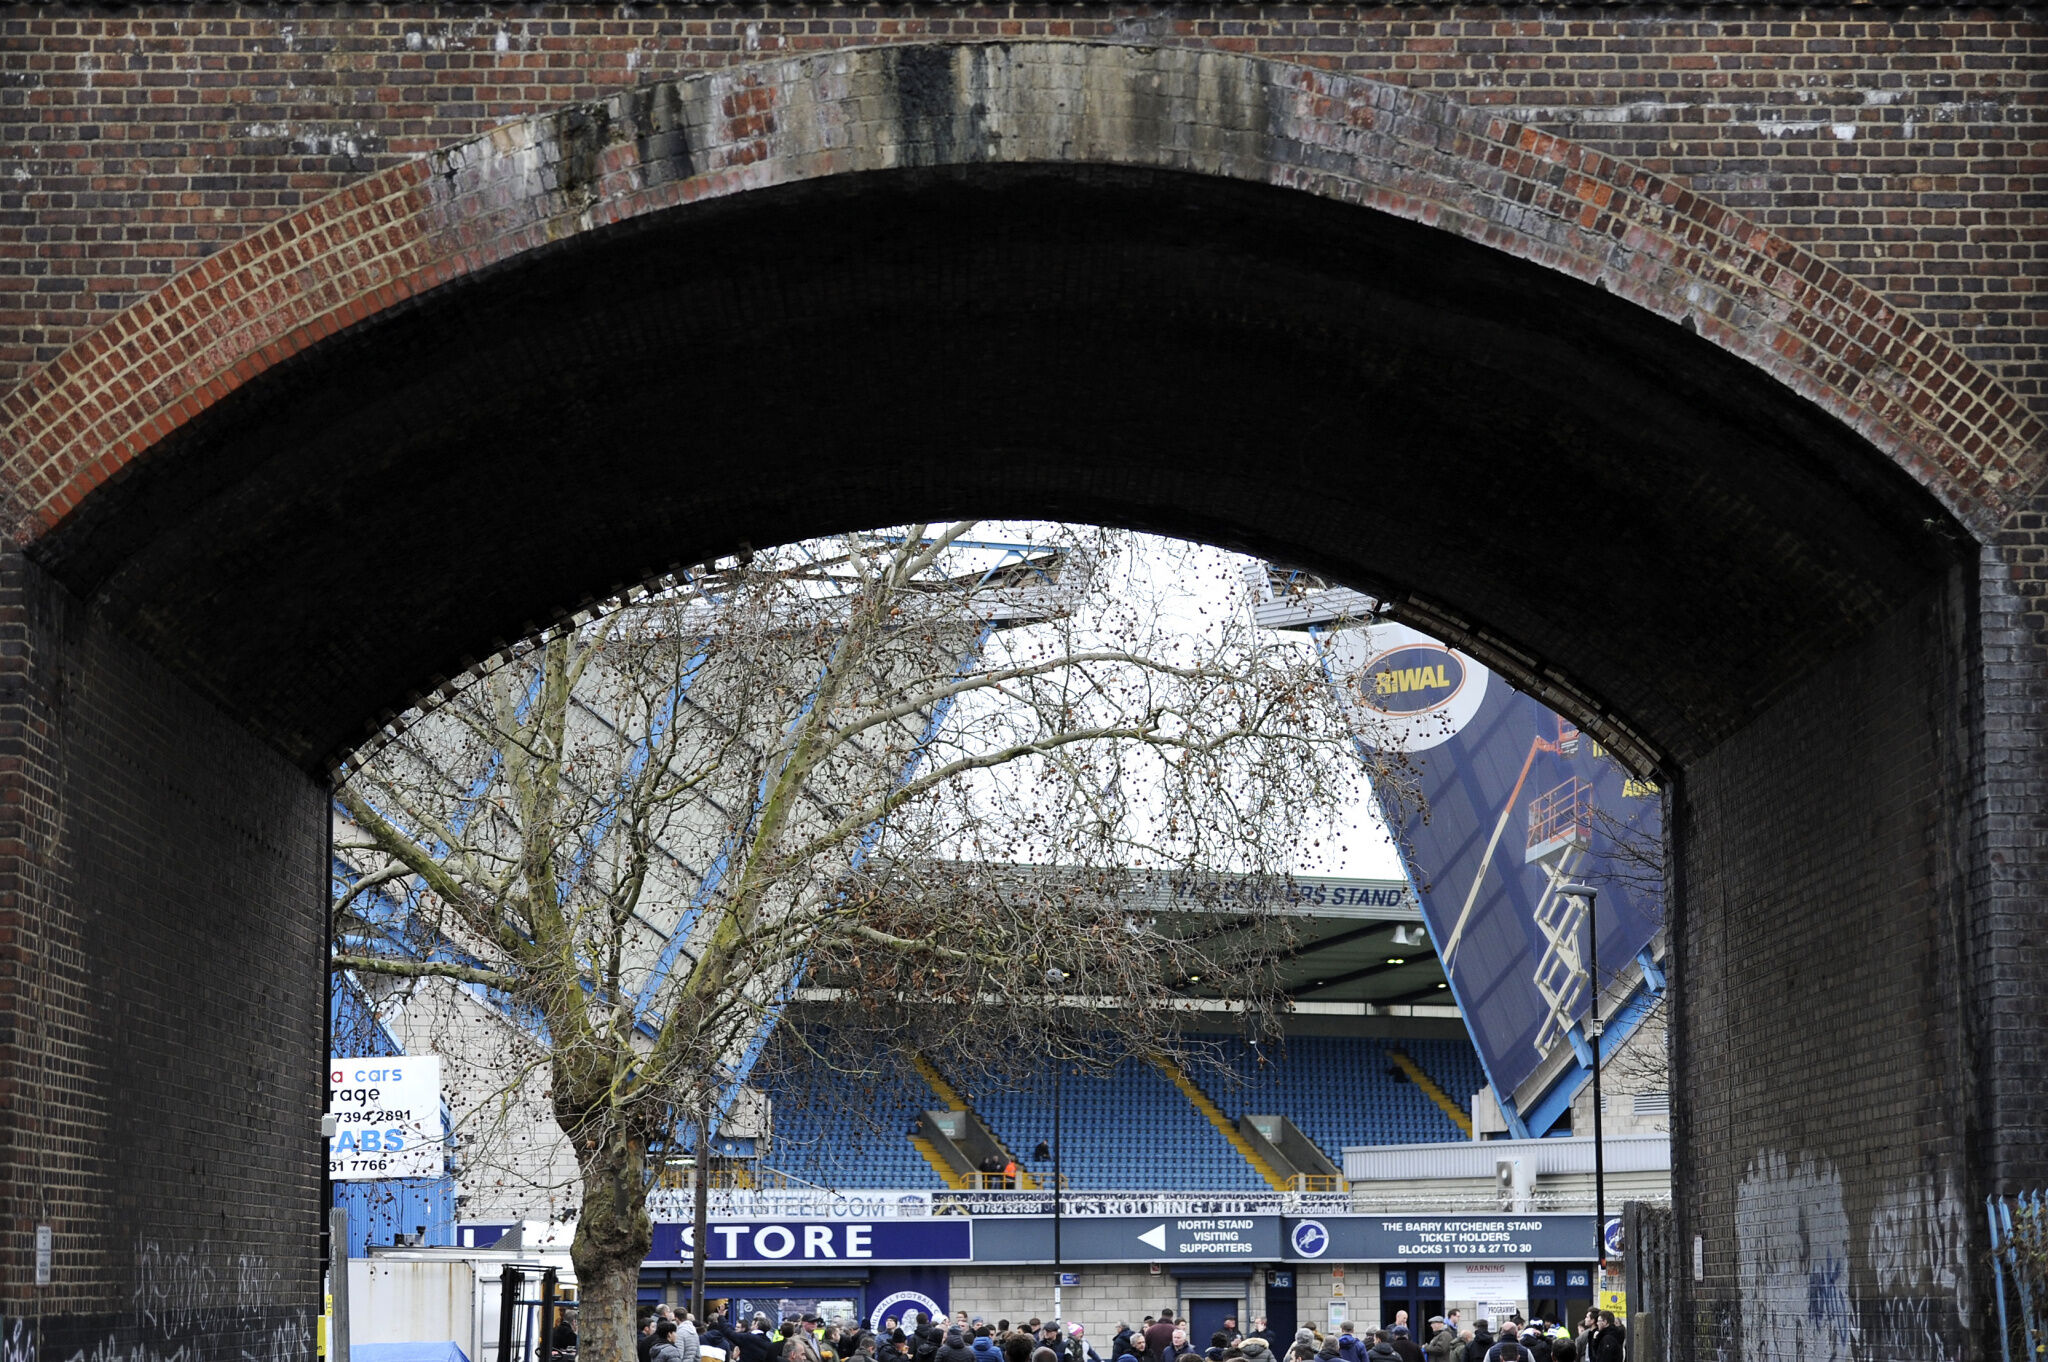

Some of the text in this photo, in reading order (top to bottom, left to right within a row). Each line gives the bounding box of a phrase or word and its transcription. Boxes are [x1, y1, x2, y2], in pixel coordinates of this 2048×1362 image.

[1376, 665, 1450, 695] RIWAL
[1332, 887, 1401, 907] STAND
[355, 1069, 402, 1082] cars
[334, 1110, 411, 1123] 7394 2891
[331, 1129, 404, 1153] ABS
[351, 1160, 387, 1171] 7766
[1177, 1220, 1254, 1230] NORTH STAND
[1382, 1221, 1543, 1231] THE BARRY KITCHENER STAND
[1194, 1231, 1239, 1241] VISITING
[1420, 1232, 1511, 1242] TICKET HOLDERS
[681, 1225, 873, 1259] STORE
[1179, 1243, 1253, 1253] SUPPORTERS
[1398, 1243, 1532, 1254] BLOCKS 1 TO 3 & 27 TO 30
[1466, 1264, 1505, 1273] WARNING
[1275, 1278, 1289, 1287] A5
[1389, 1276, 1404, 1286] A6
[1422, 1276, 1436, 1286] A7
[1536, 1275, 1552, 1285] A8
[1570, 1275, 1585, 1285] A9
